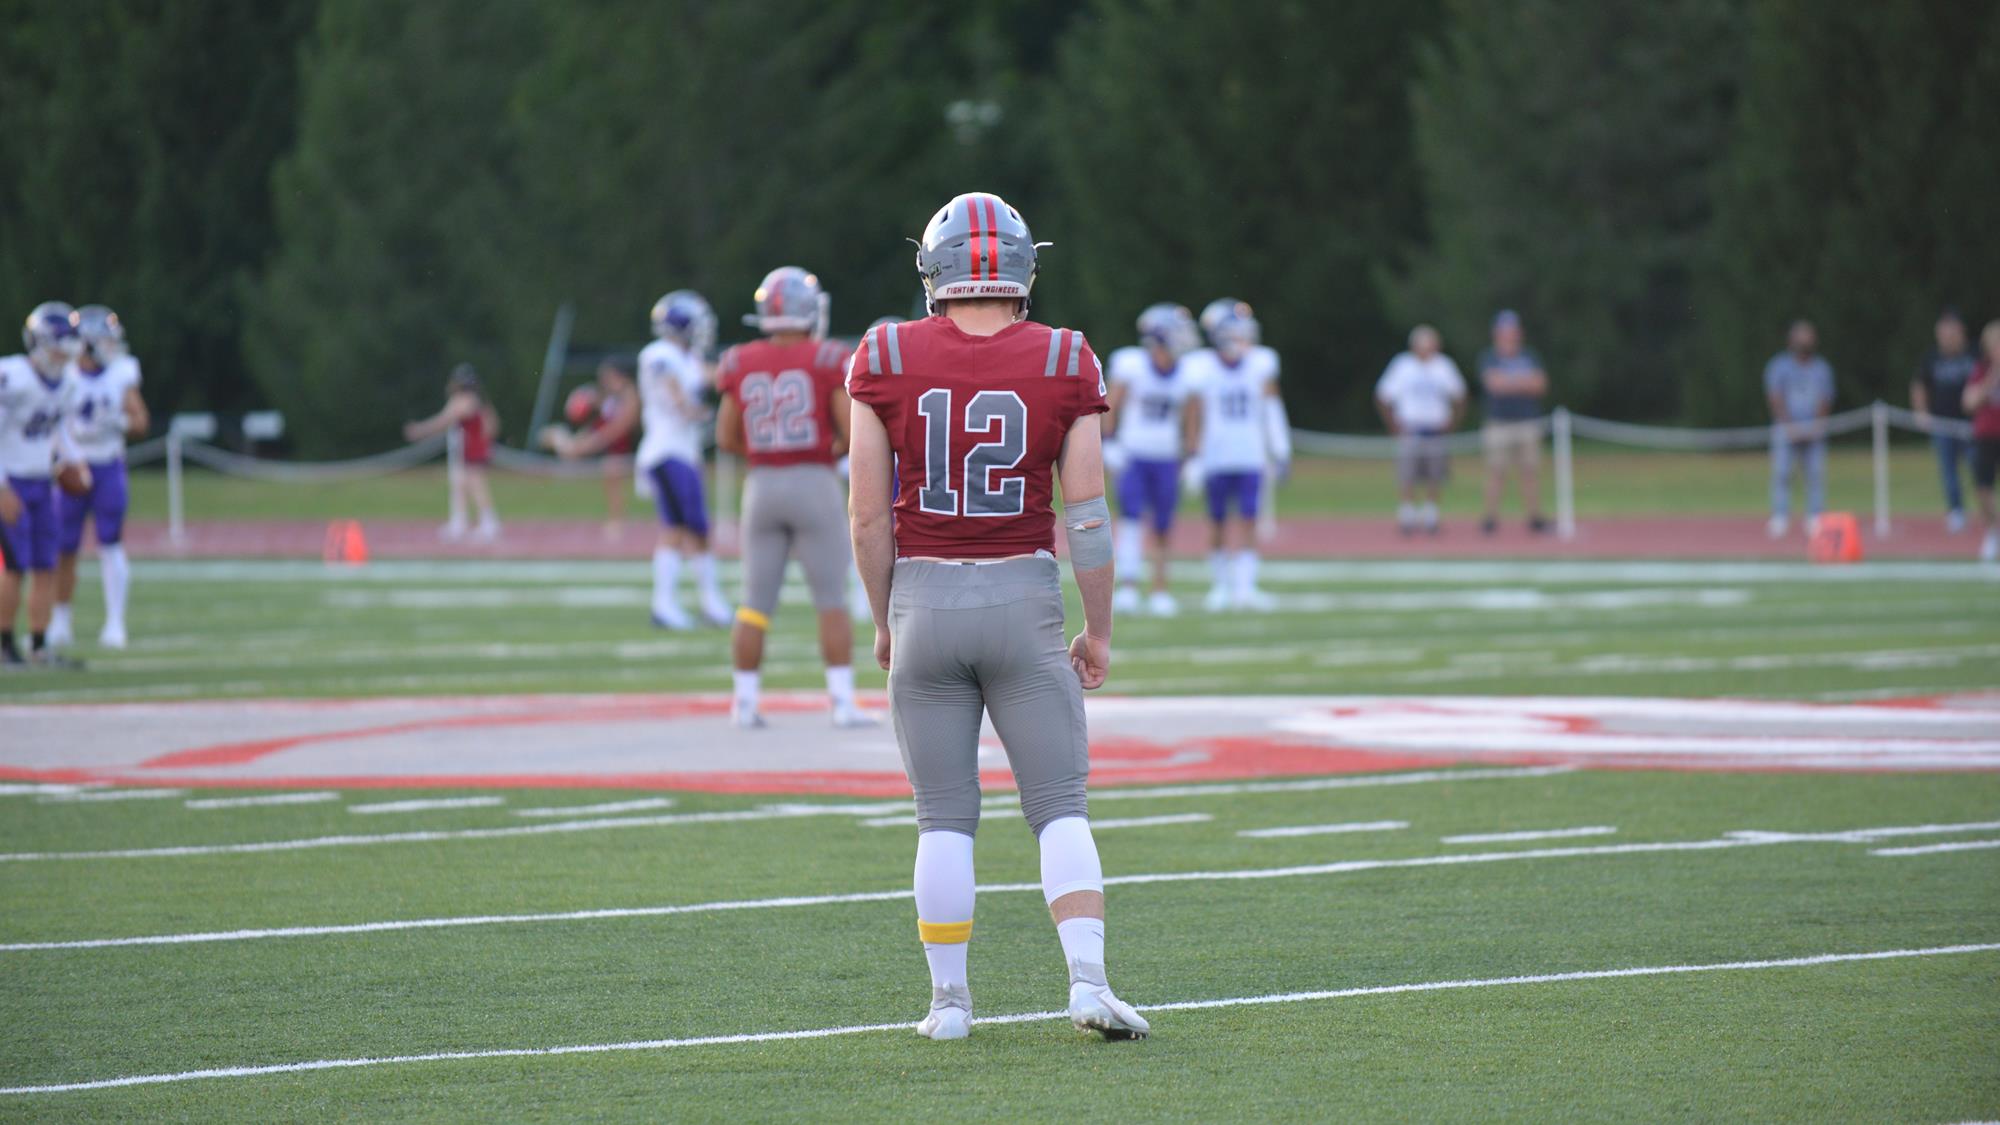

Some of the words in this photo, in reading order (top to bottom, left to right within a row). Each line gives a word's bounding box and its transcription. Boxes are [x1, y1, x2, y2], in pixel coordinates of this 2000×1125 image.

[946, 286, 977, 295] FIGHTIN'
[980, 286, 1019, 294] ENGINEERS
[739, 368, 820, 450] 22
[918, 388, 1027, 517] 12
